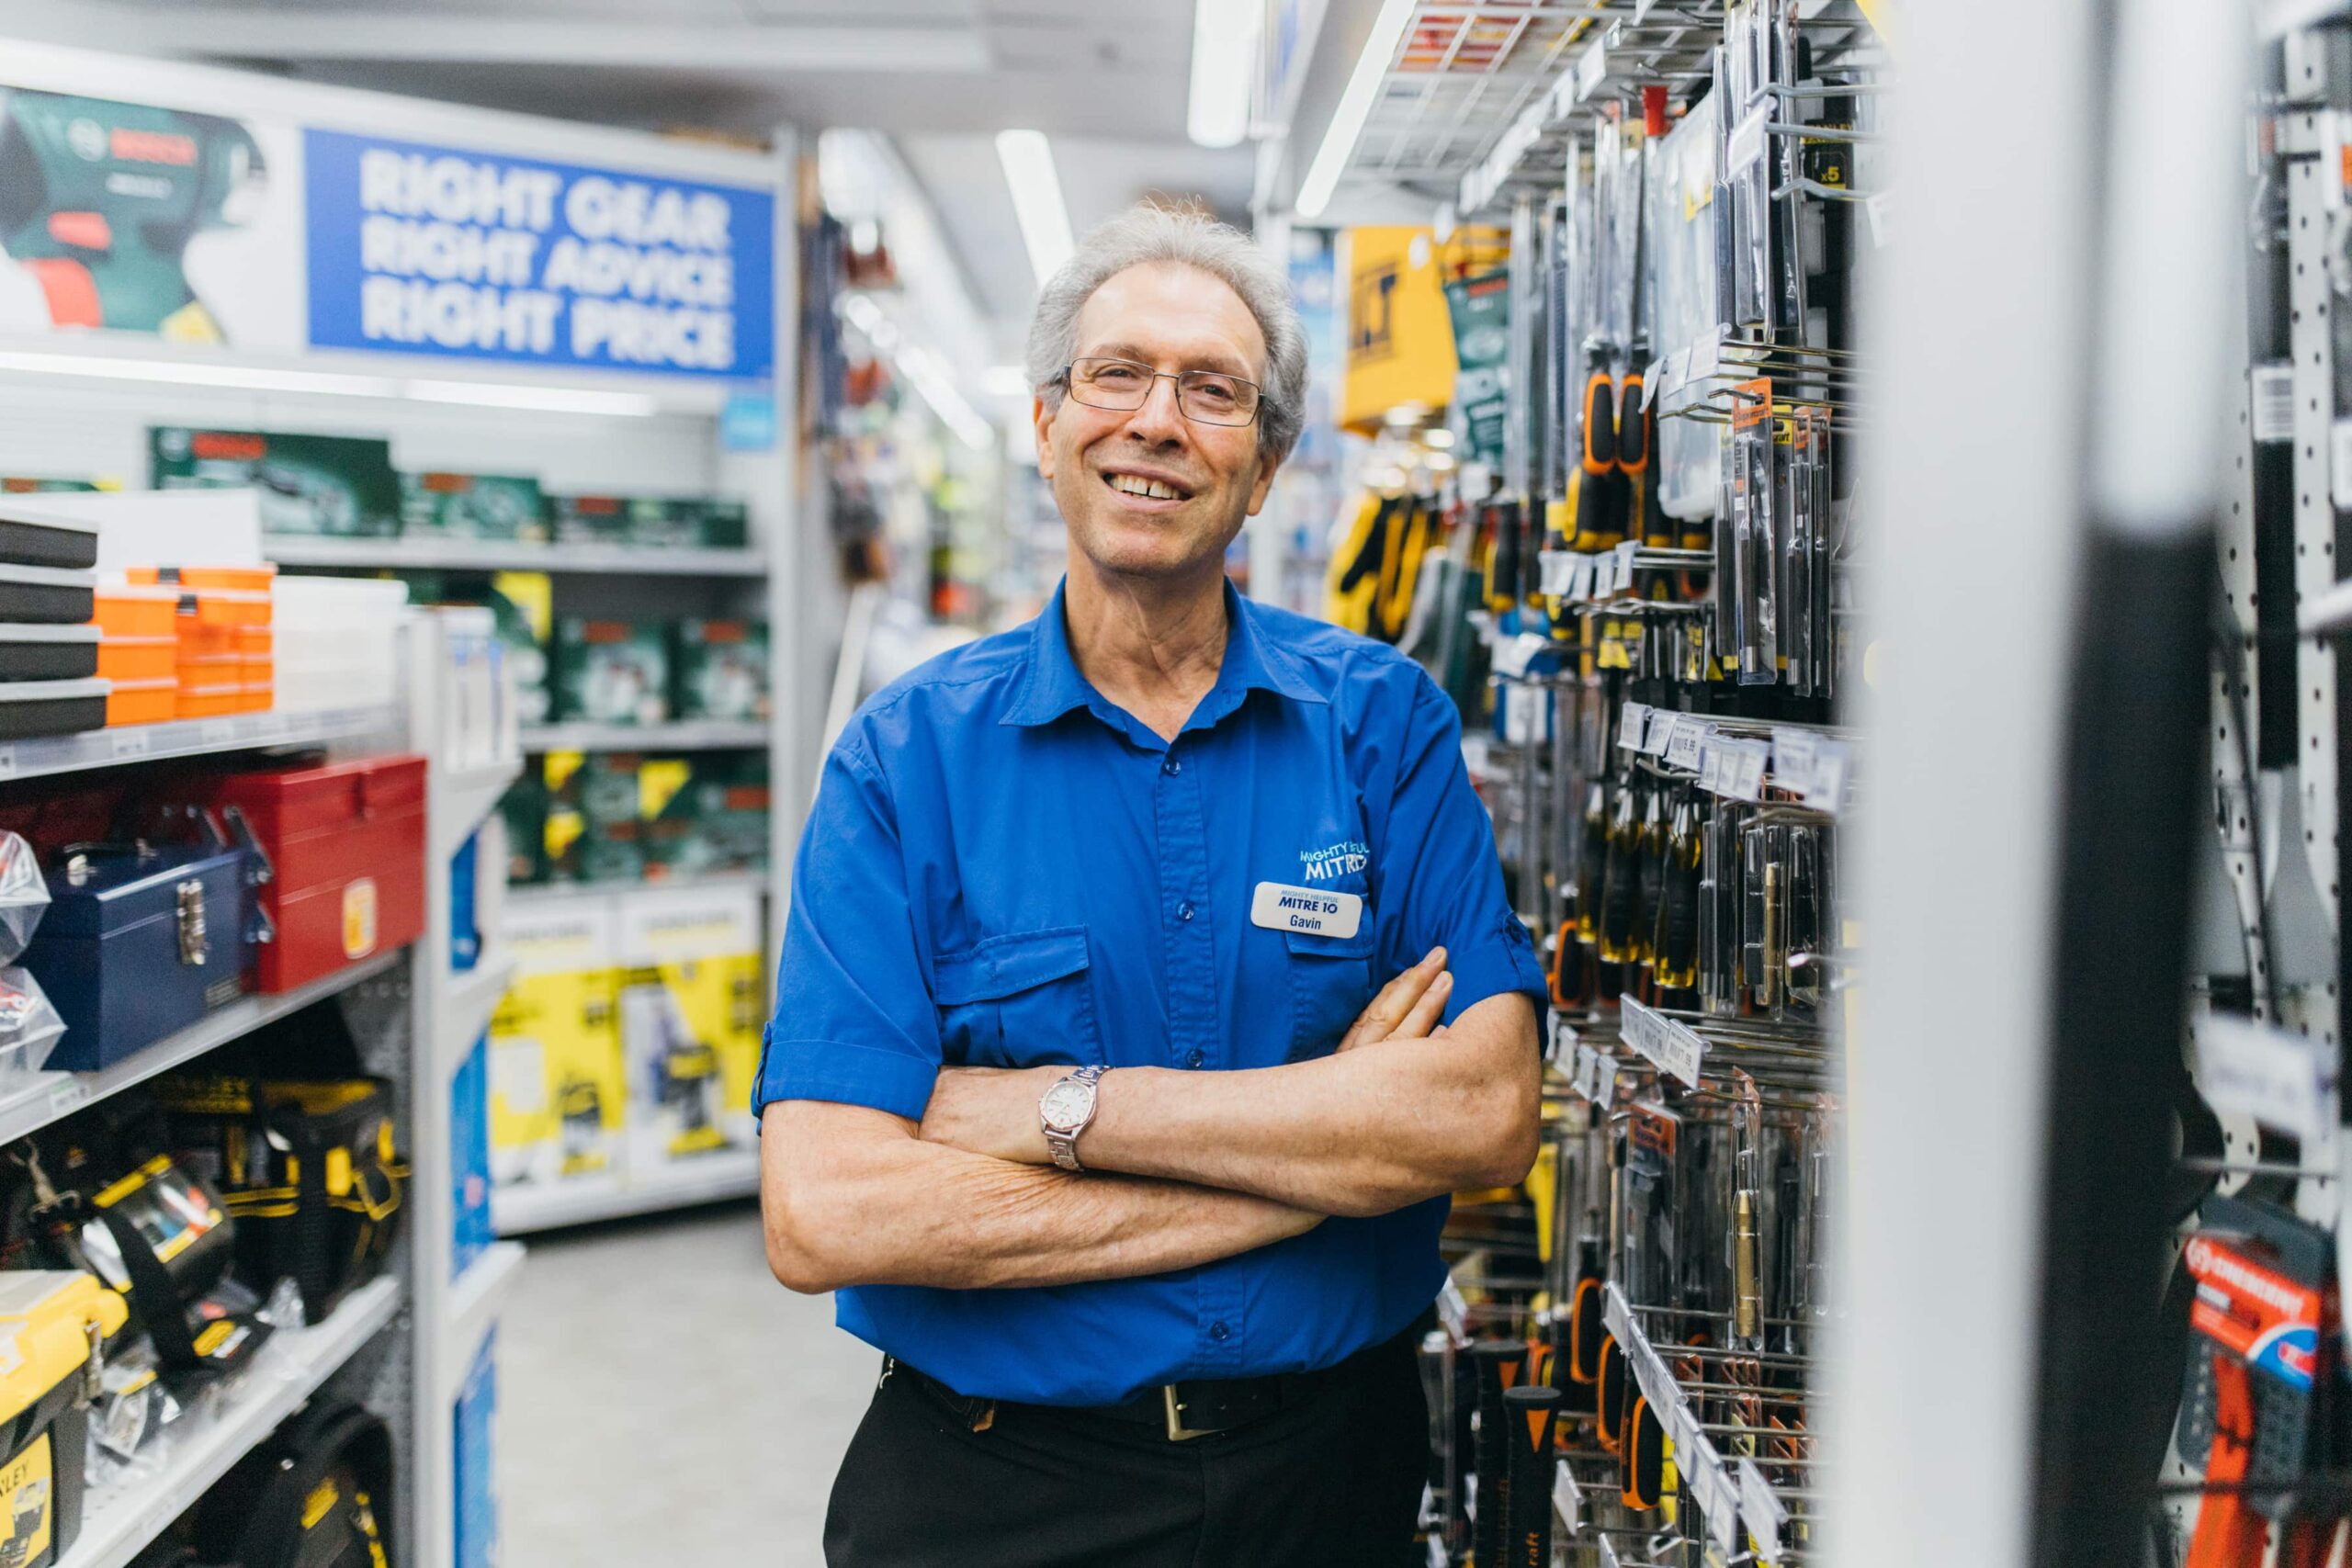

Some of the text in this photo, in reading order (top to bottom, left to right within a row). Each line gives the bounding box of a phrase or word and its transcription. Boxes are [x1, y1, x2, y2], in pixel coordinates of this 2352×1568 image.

[1822, 165, 1839, 183] x5
[360, 148, 732, 251] RIGHT GEAR
[360, 215, 734, 307] RIGHT ADVICE
[360, 276, 736, 369] RIGHT PRICE
[1300, 841, 1348, 862] MIGHTY
[1279, 897, 1338, 913] MITRE 10
[1310, 894, 1338, 903] HELPFUL
[1290, 915, 1321, 930] Gavin
